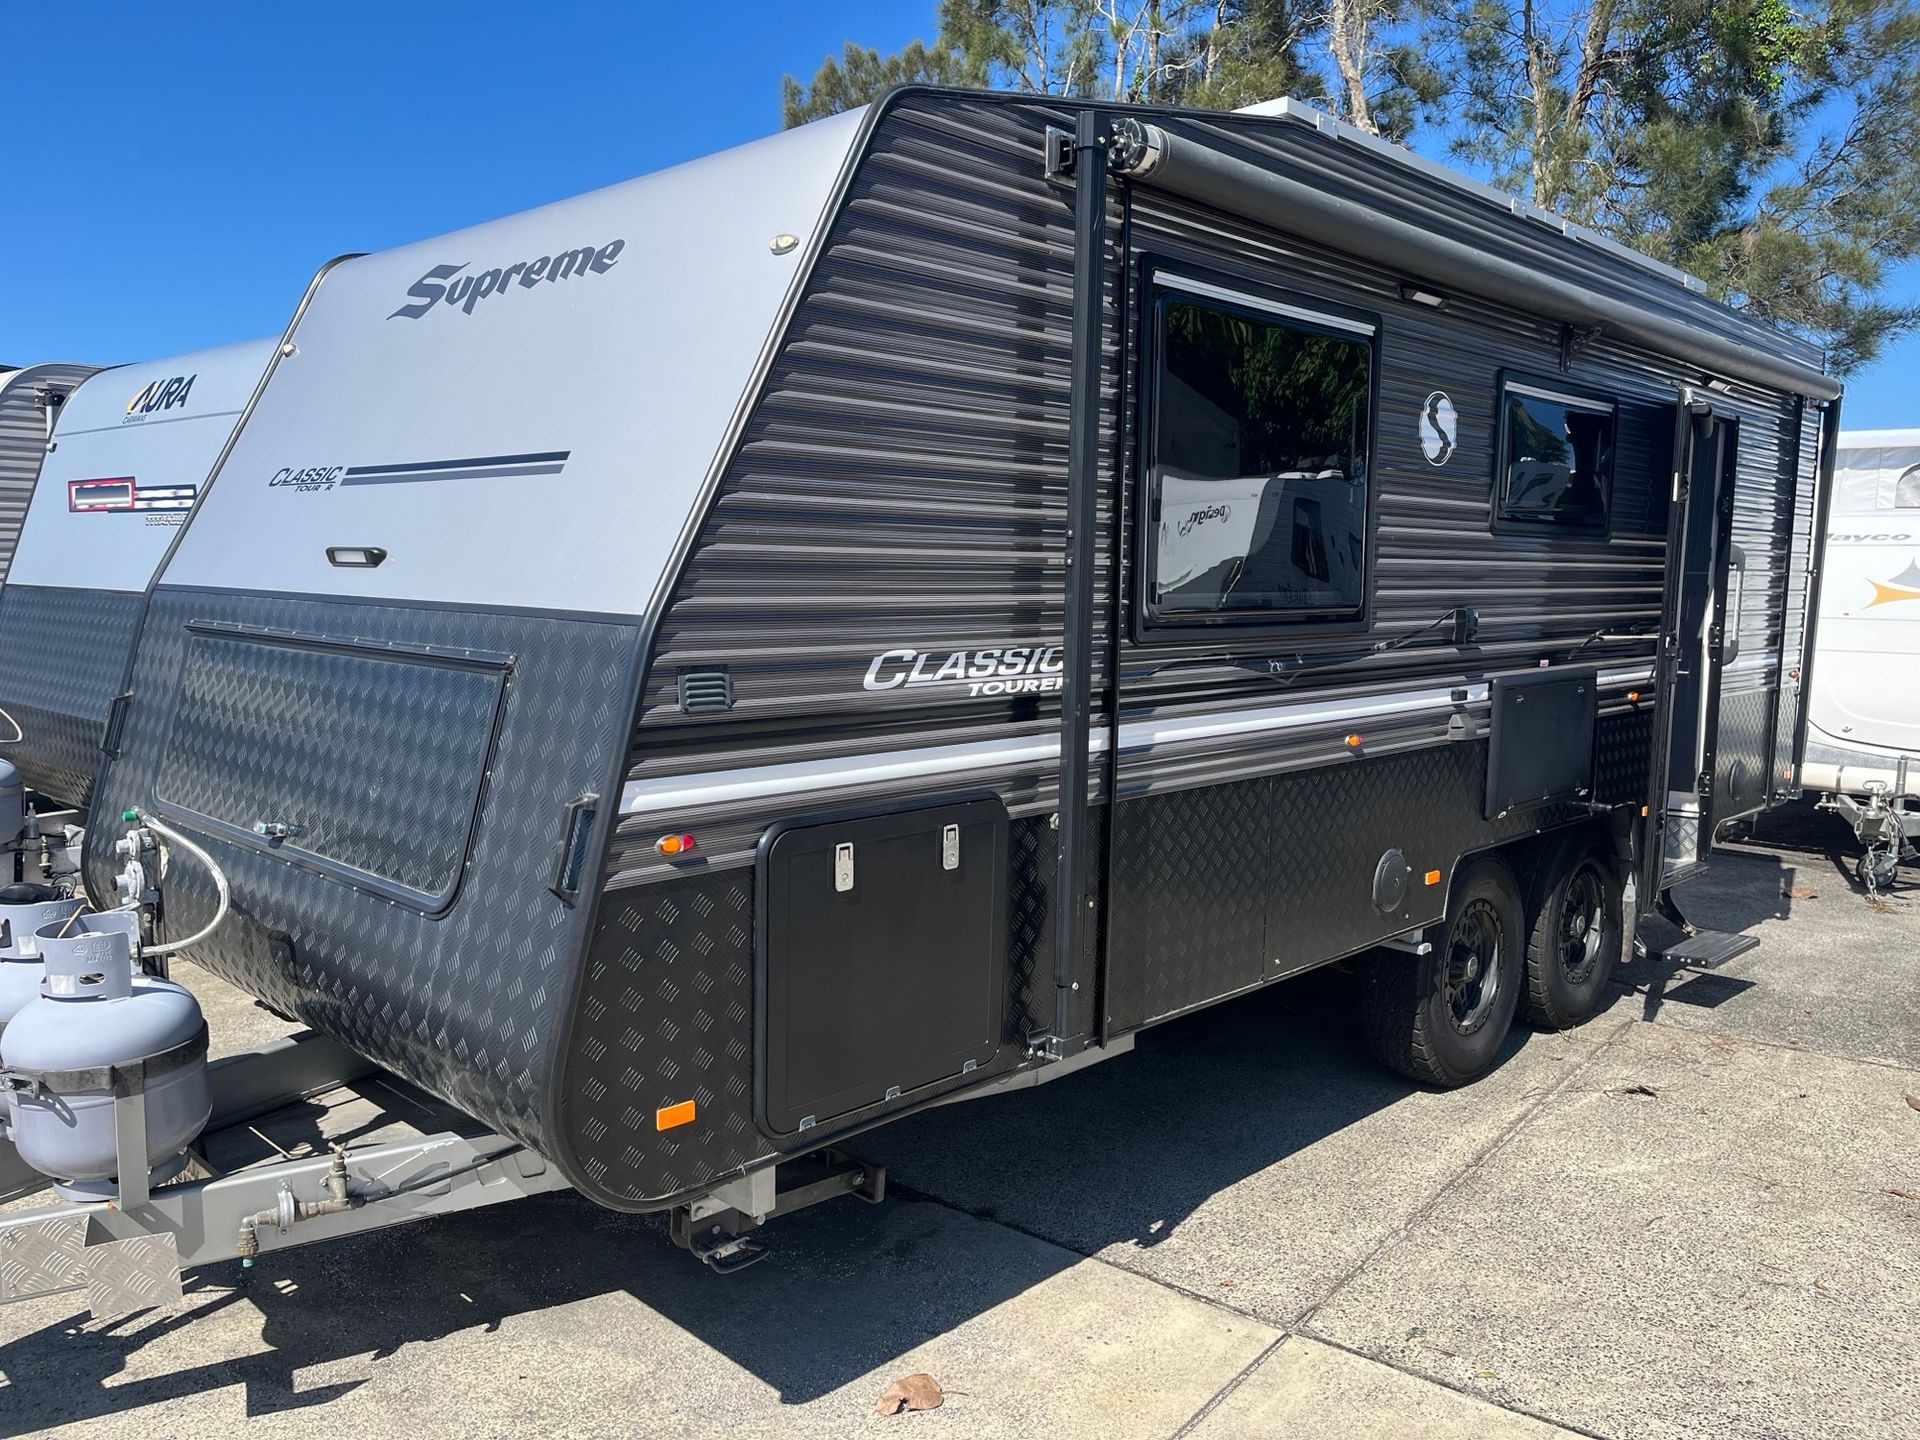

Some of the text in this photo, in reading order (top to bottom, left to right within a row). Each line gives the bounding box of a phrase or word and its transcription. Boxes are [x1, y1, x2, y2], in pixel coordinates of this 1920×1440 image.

[386, 238, 625, 321] Supreme
[127, 374, 197, 415] AURA
[268, 466, 344, 487] CLASSIC
[863, 646, 1064, 691] CLASSIC
